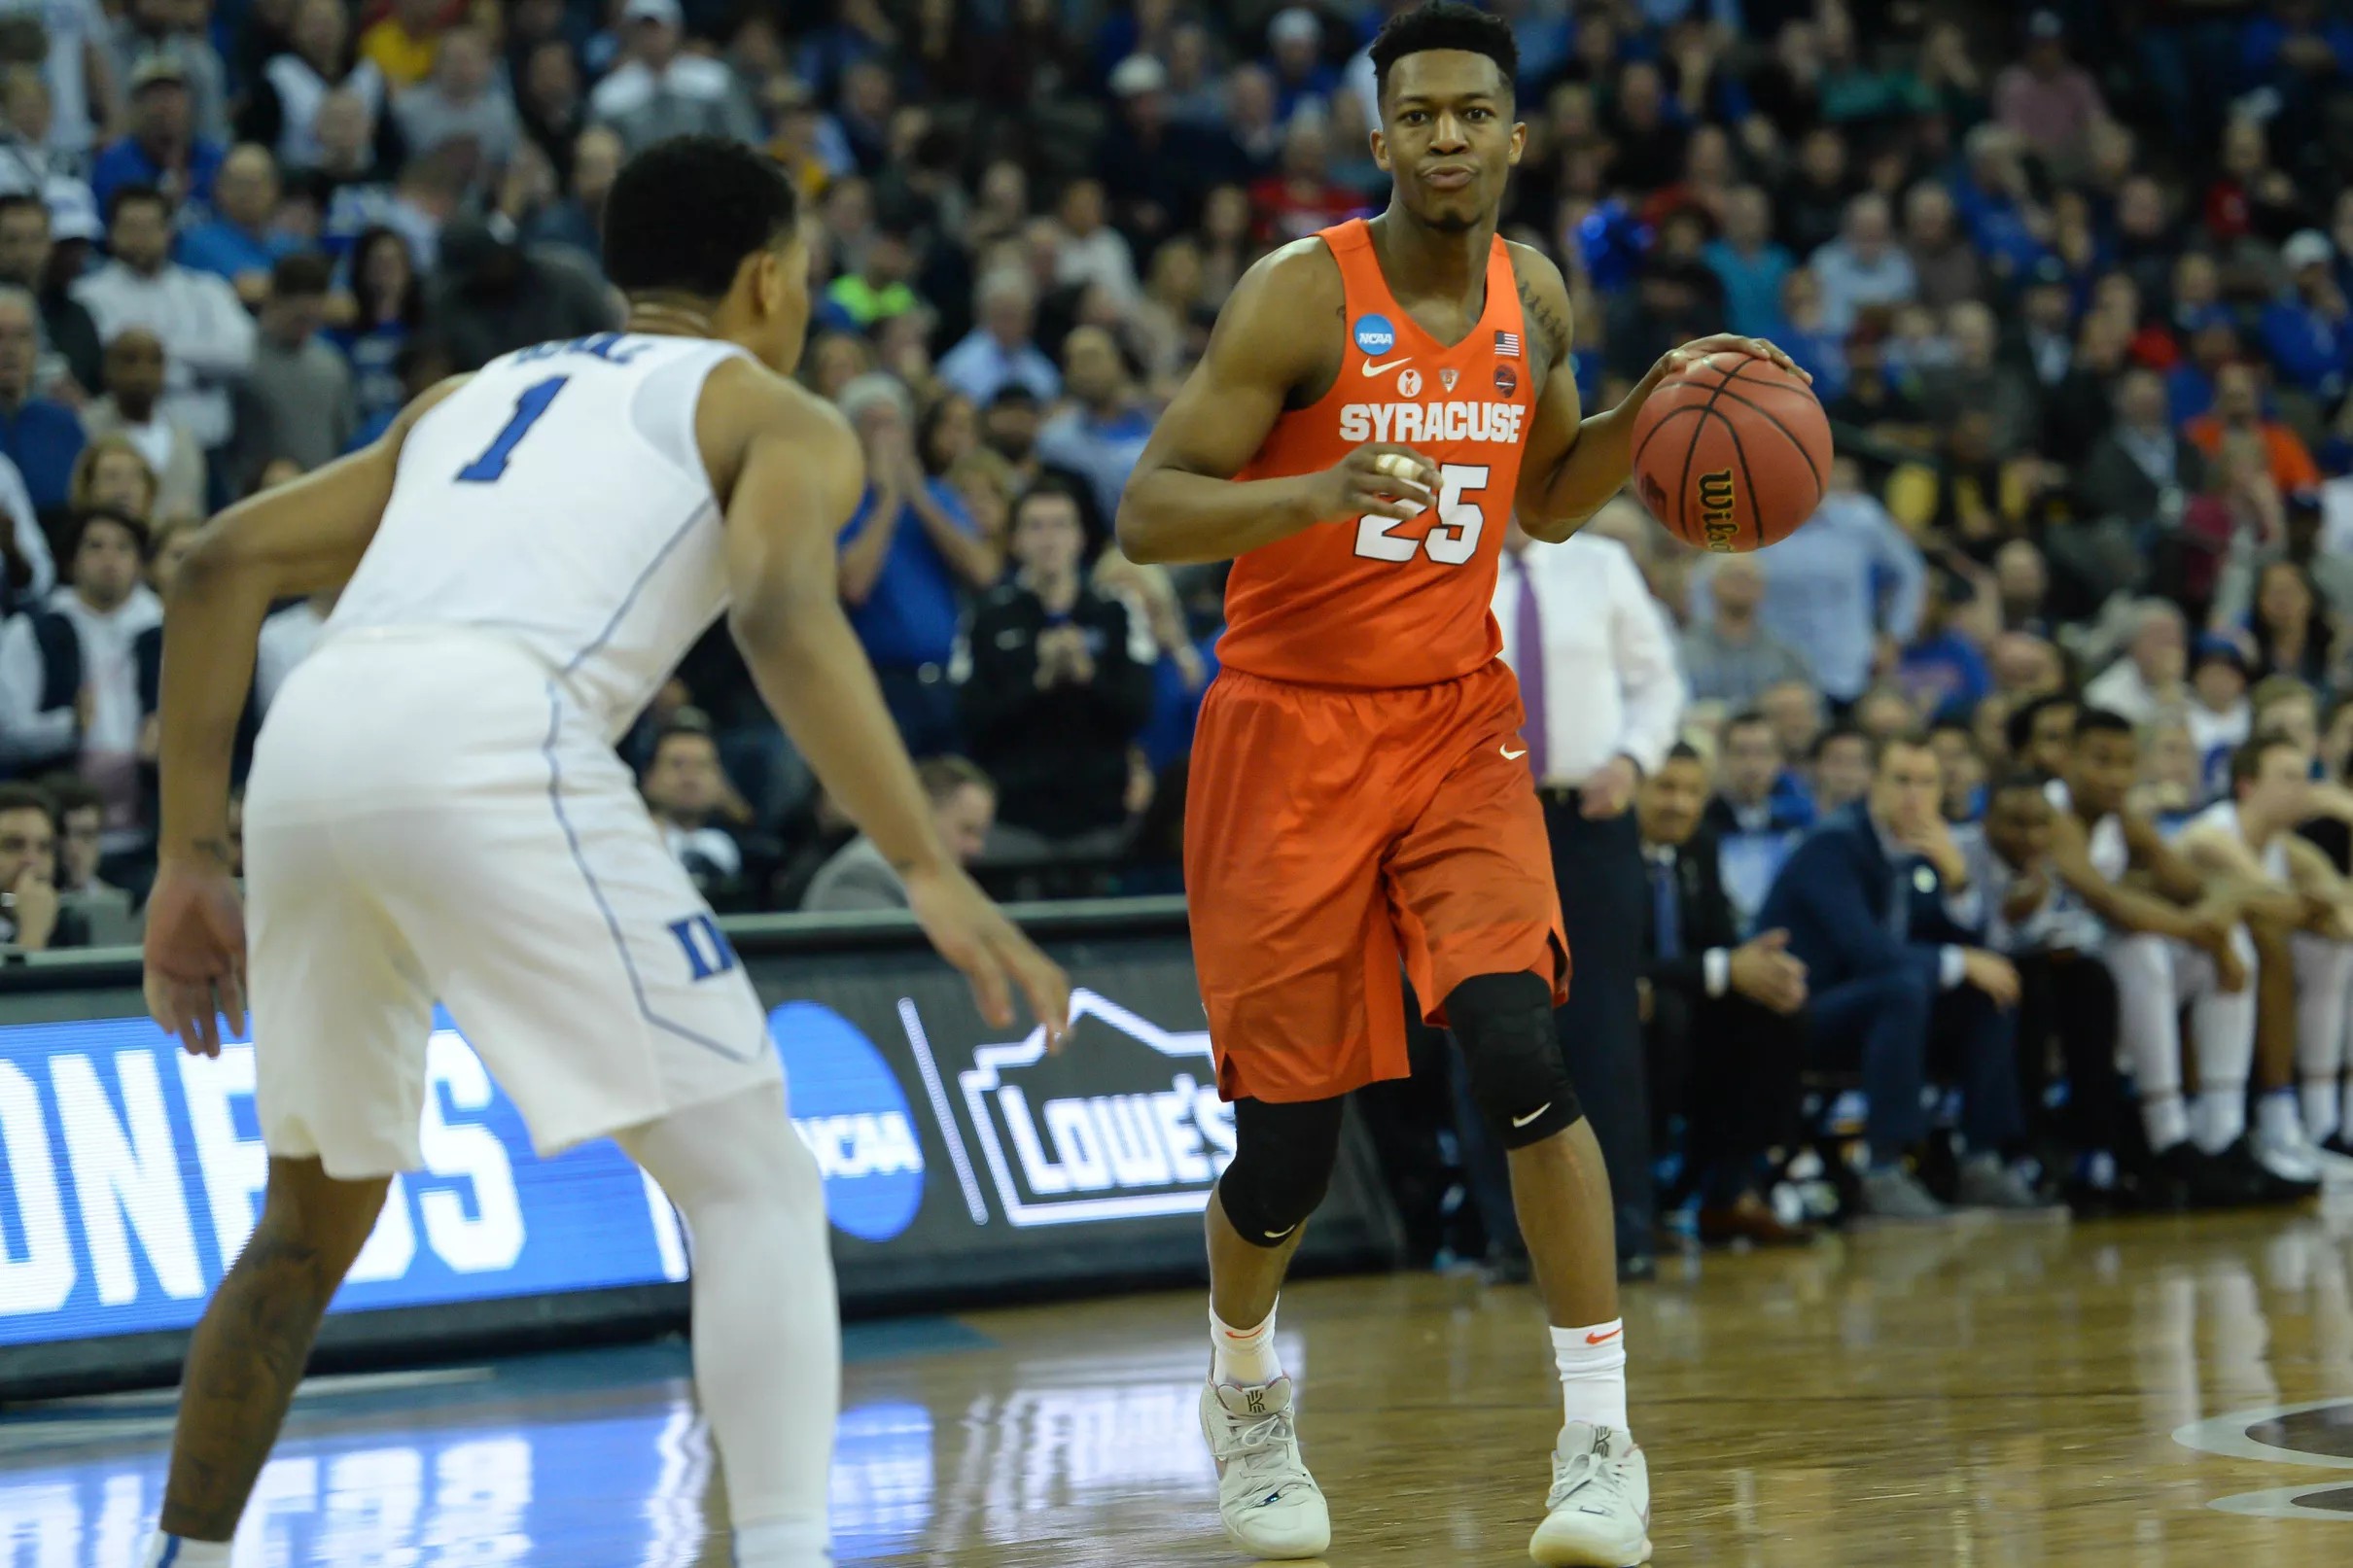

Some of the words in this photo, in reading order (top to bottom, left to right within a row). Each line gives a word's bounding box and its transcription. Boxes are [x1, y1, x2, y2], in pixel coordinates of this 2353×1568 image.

[1359, 332, 1392, 344] NCAA
[457, 375, 569, 481] 1
[1339, 401, 1526, 443] SYRACUSE
[1353, 462, 1490, 565] 25
[998, 1072, 1237, 1195] LOWE'S
